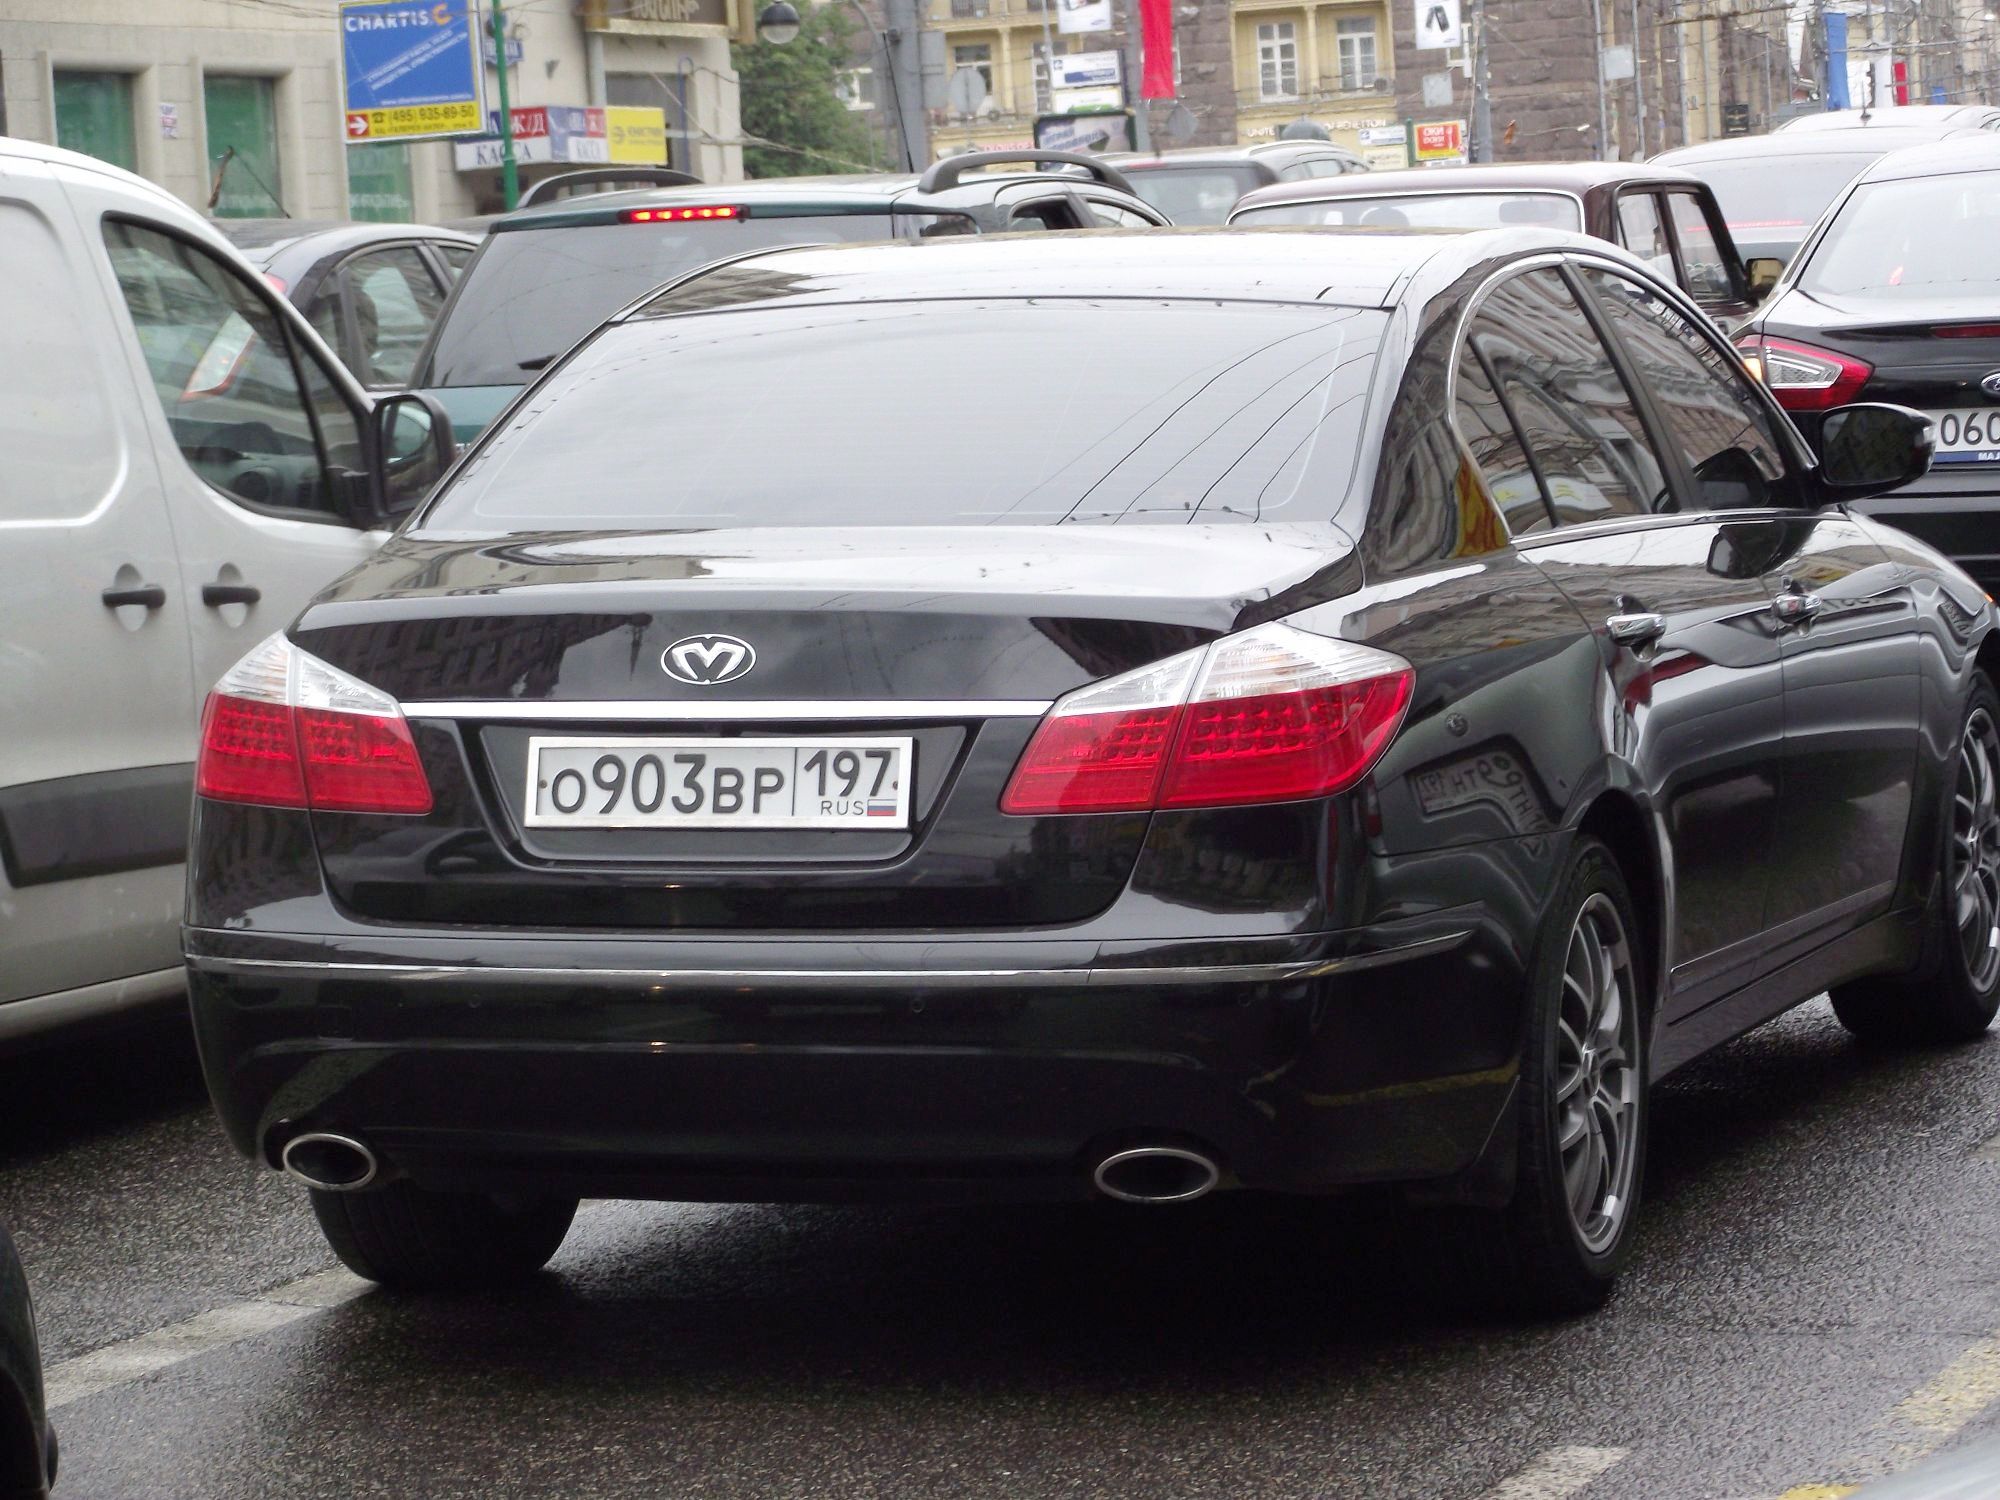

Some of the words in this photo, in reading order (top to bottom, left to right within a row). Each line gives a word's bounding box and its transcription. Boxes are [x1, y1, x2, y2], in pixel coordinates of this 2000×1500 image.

[344, 9, 430, 33] CHARTIS
[803, 749, 892, 797] 197
[820, 800, 865, 816] RUS
